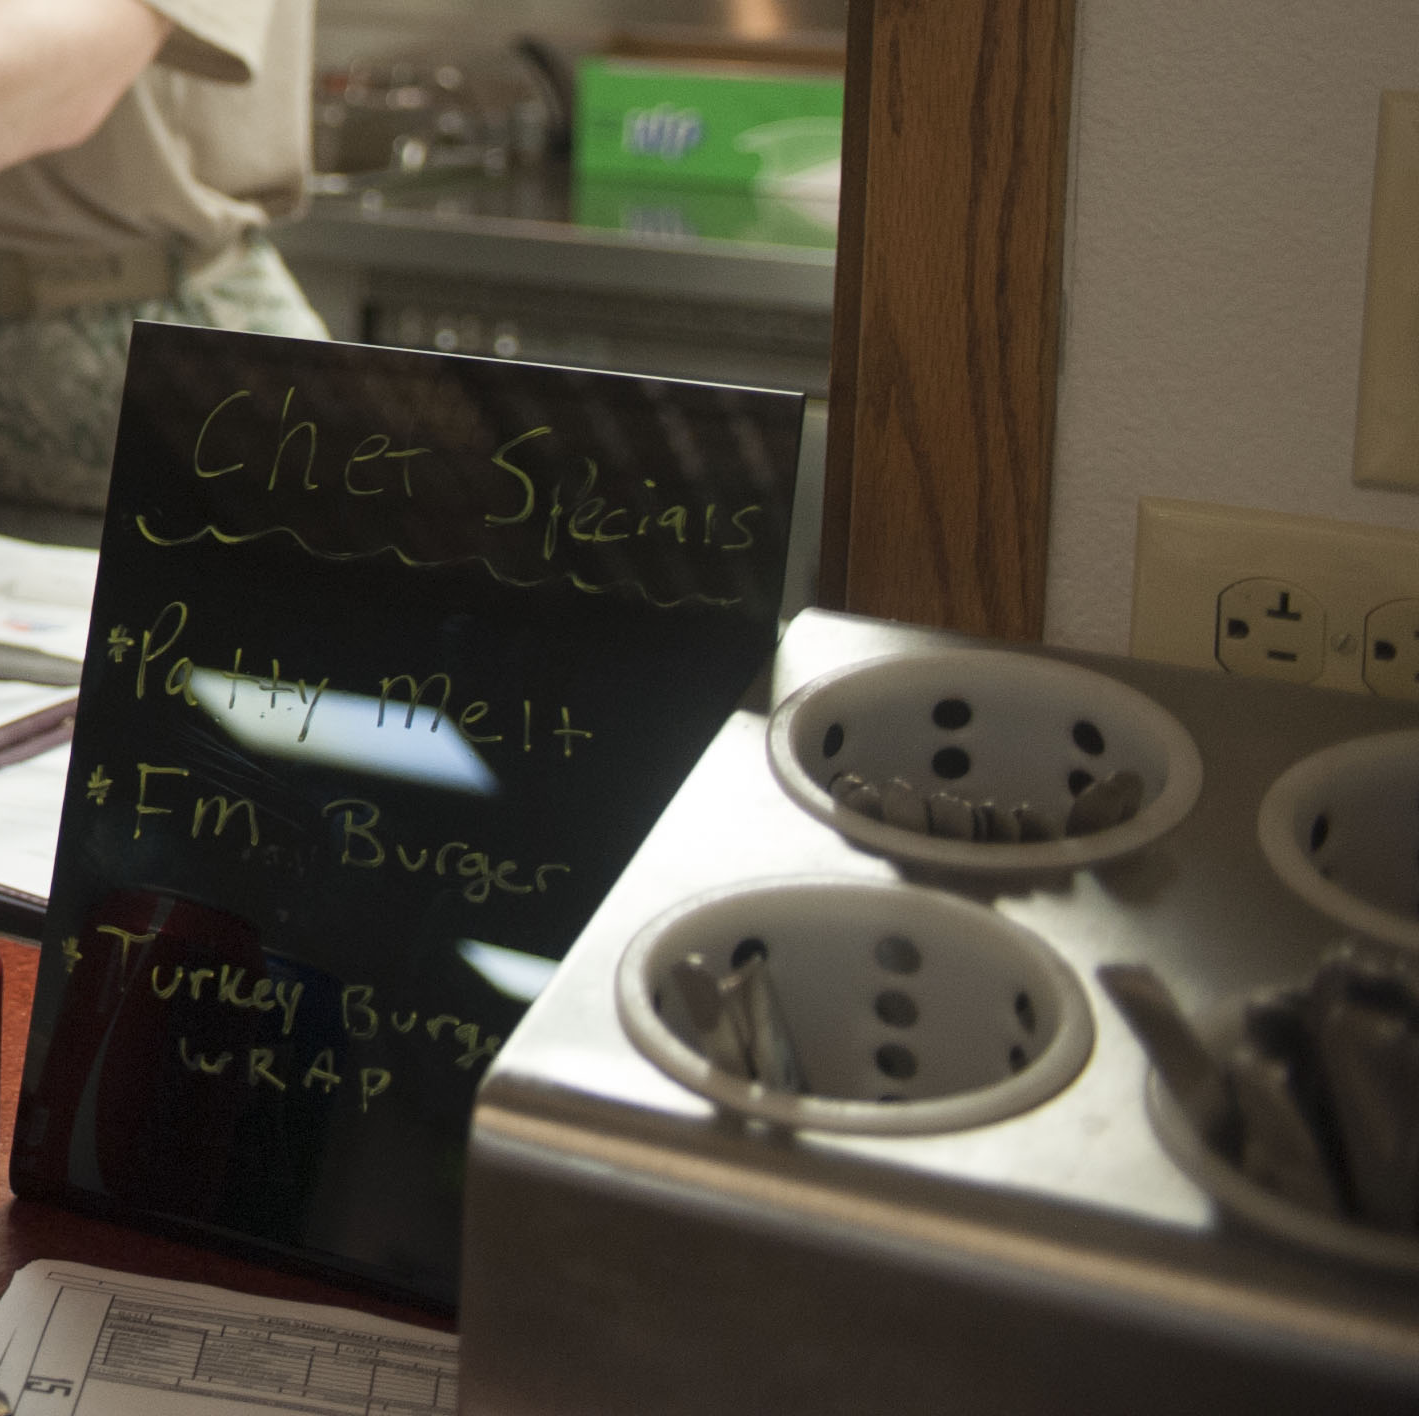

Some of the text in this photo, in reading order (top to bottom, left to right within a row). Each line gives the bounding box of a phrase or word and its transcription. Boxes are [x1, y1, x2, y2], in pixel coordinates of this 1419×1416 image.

[135, 600, 331, 744] Patty
[320, 798, 572, 904] Burger
[95, 923, 502, 1072] Turkey Burge
